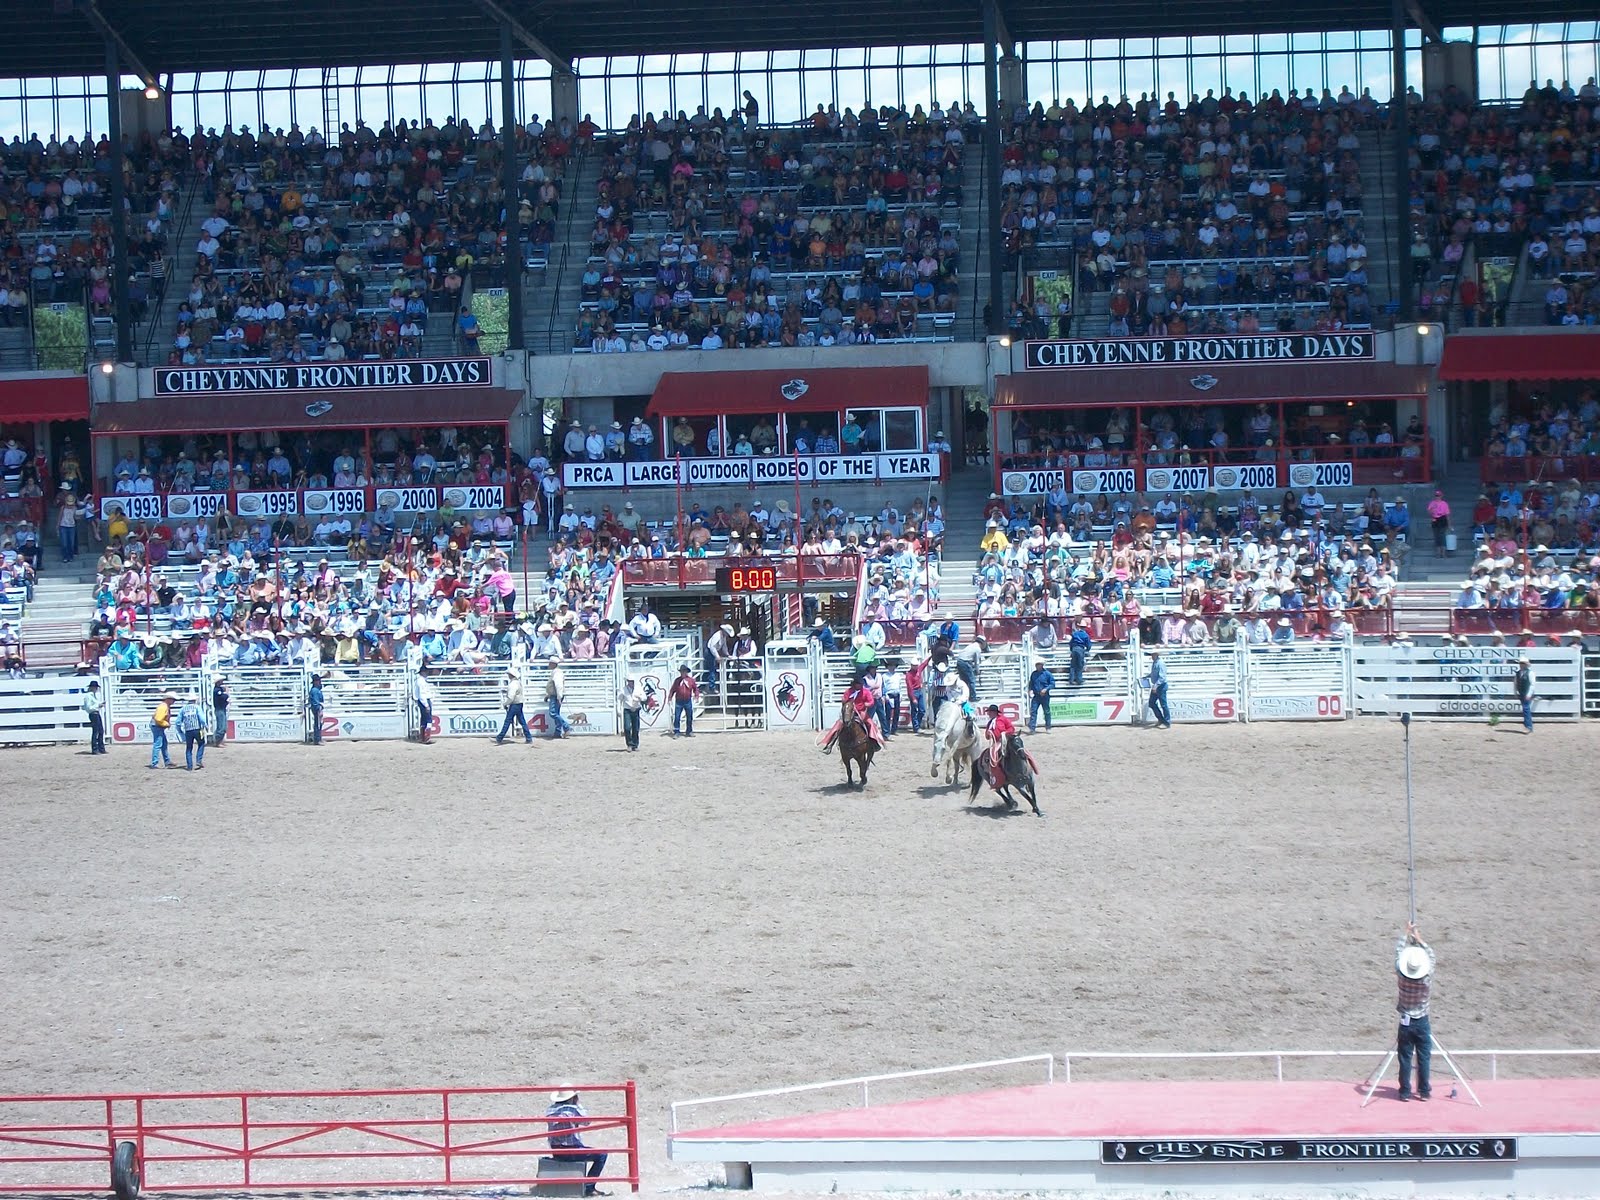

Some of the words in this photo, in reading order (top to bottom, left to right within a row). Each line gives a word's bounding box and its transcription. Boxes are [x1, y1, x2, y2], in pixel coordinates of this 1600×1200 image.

[1037, 341, 1166, 365] CHEYENNE
[1173, 337, 1294, 361] FRONTIER
[1304, 335, 1364, 358] DAYS
[165, 368, 289, 392] CHEYENNE
[296, 364, 413, 388] FRONTIER
[421, 361, 480, 384] DAYS
[574, 466, 614, 483] PRCA
[691, 463, 749, 480] OUTDOOR
[756, 461, 809, 478] RODEO
[818, 460, 838, 476] OF
[843, 459, 873, 475] THE
[888, 457, 931, 474] YEAR
[1172, 469, 1207, 490] 2007
[1239, 466, 1275, 488] 2008
[1315, 464, 1350, 486] 2009
[1099, 471, 1134, 492] 2006
[126, 496, 160, 518] 1993
[261, 492, 296, 514] 1995
[328, 491, 363, 512] 1996
[402, 488, 436, 510] 2000
[468, 487, 502, 509] 2004
[1440, 665, 1519, 675] FRONTIER
[1460, 683, 1499, 693] DAYS
[1104, 700, 1125, 720] 7
[1213, 698, 1234, 718] 8
[1317, 695, 1341, 716] 00
[321, 717, 339, 736] 2
[449, 717, 497, 730] Union
[527, 713, 549, 733] 4
[1138, 1142, 1285, 1159] CHEYENNE
[1301, 1143, 1413, 1157] FRONTIER
[1425, 1143, 1480, 1156] DAYS
